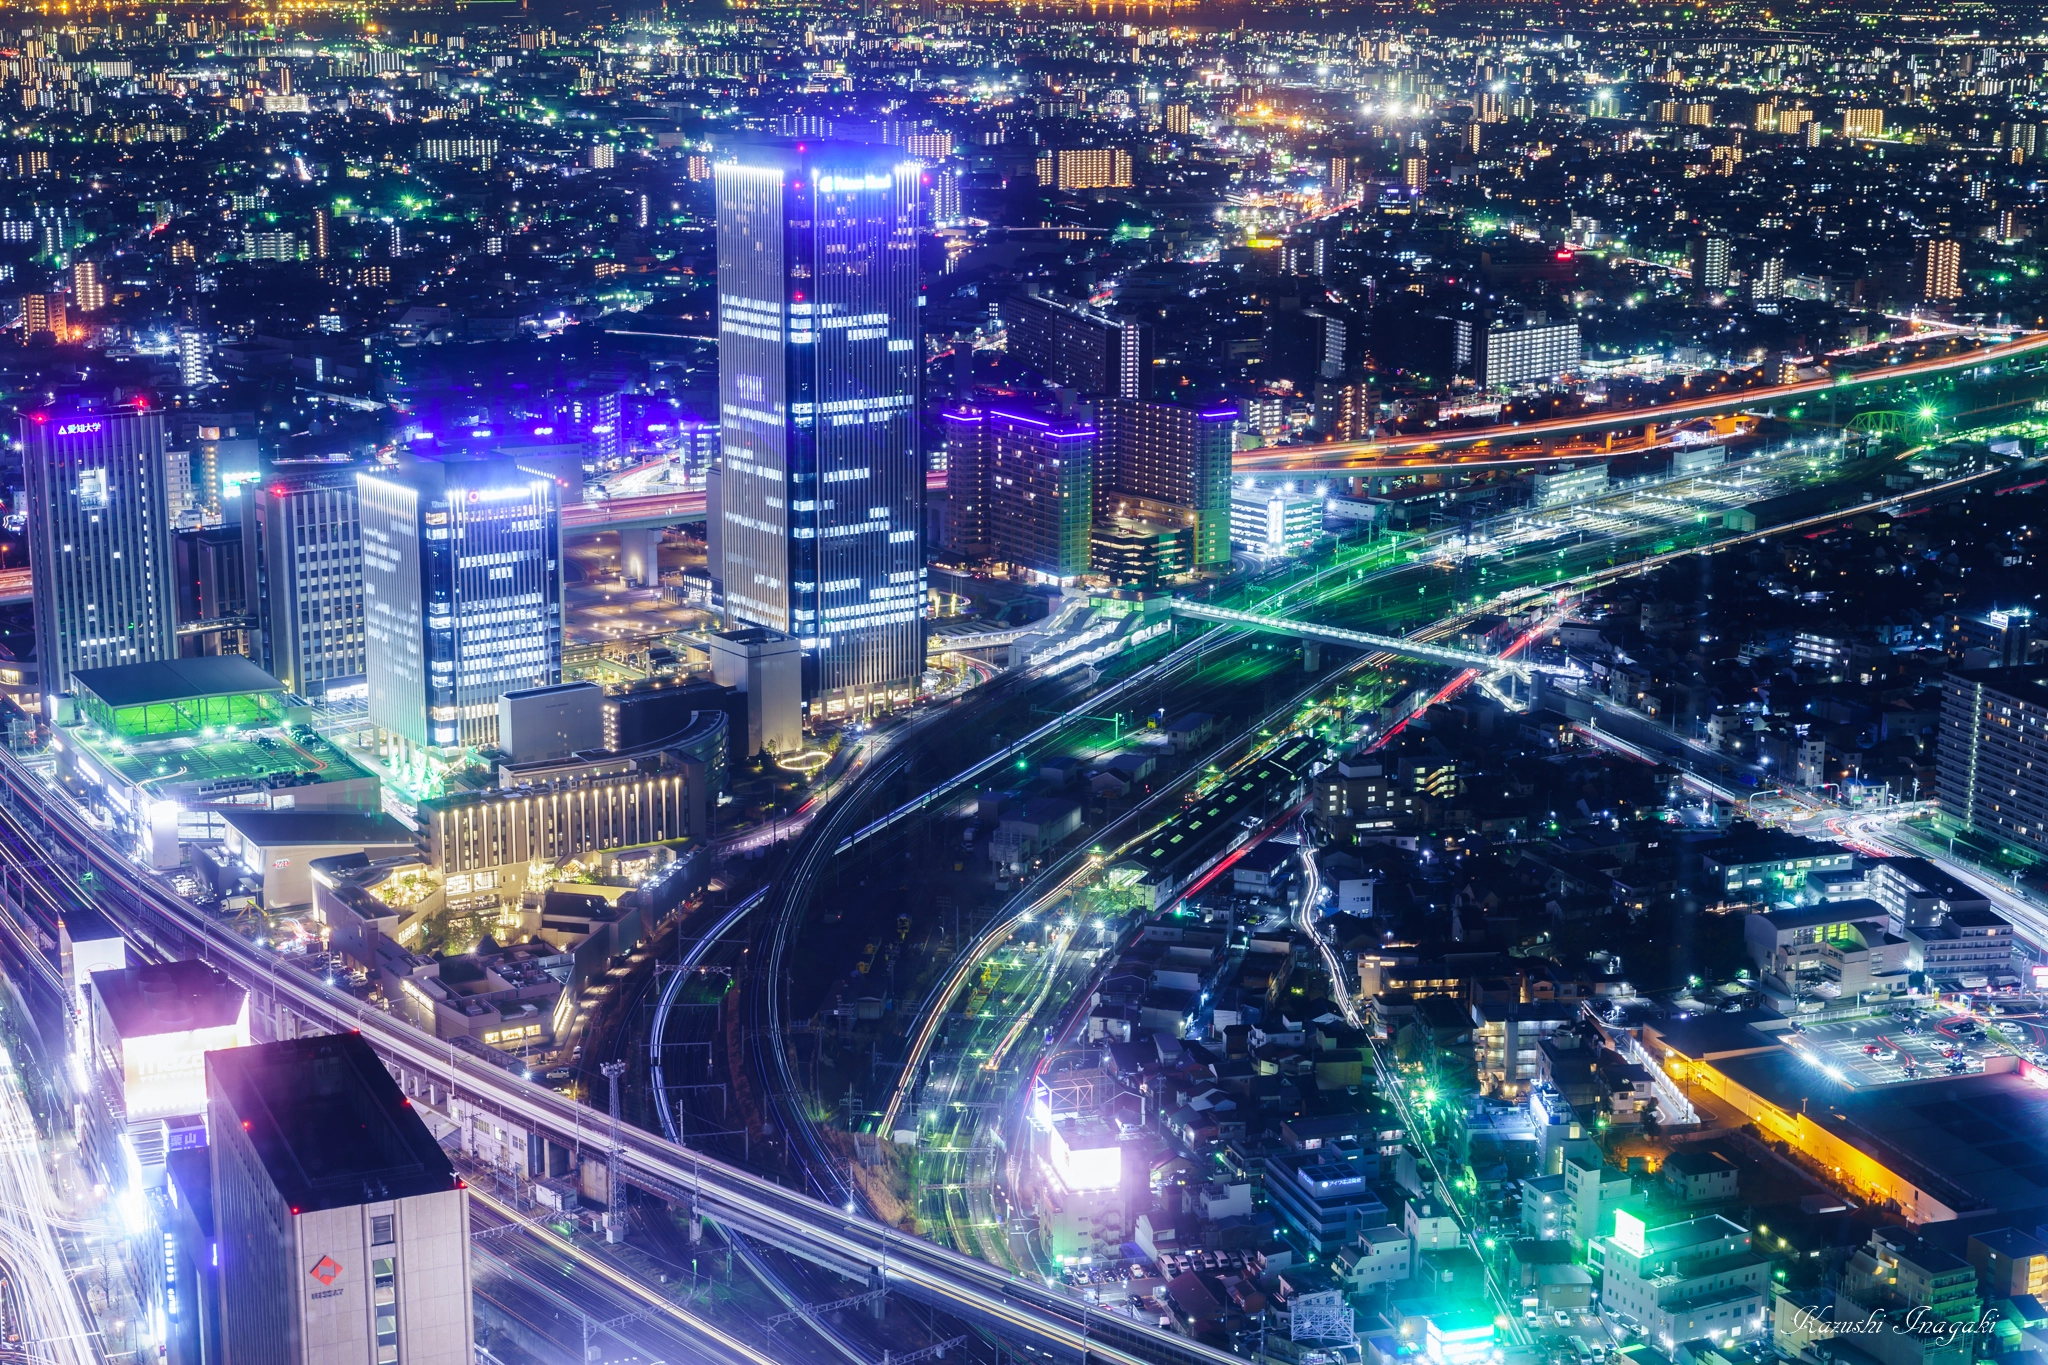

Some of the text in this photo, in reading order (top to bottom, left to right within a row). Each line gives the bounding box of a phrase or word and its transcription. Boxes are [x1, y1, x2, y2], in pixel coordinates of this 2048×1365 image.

[67, 422, 101, 435] 愛知大学
[138, 1046, 209, 1075] maza
